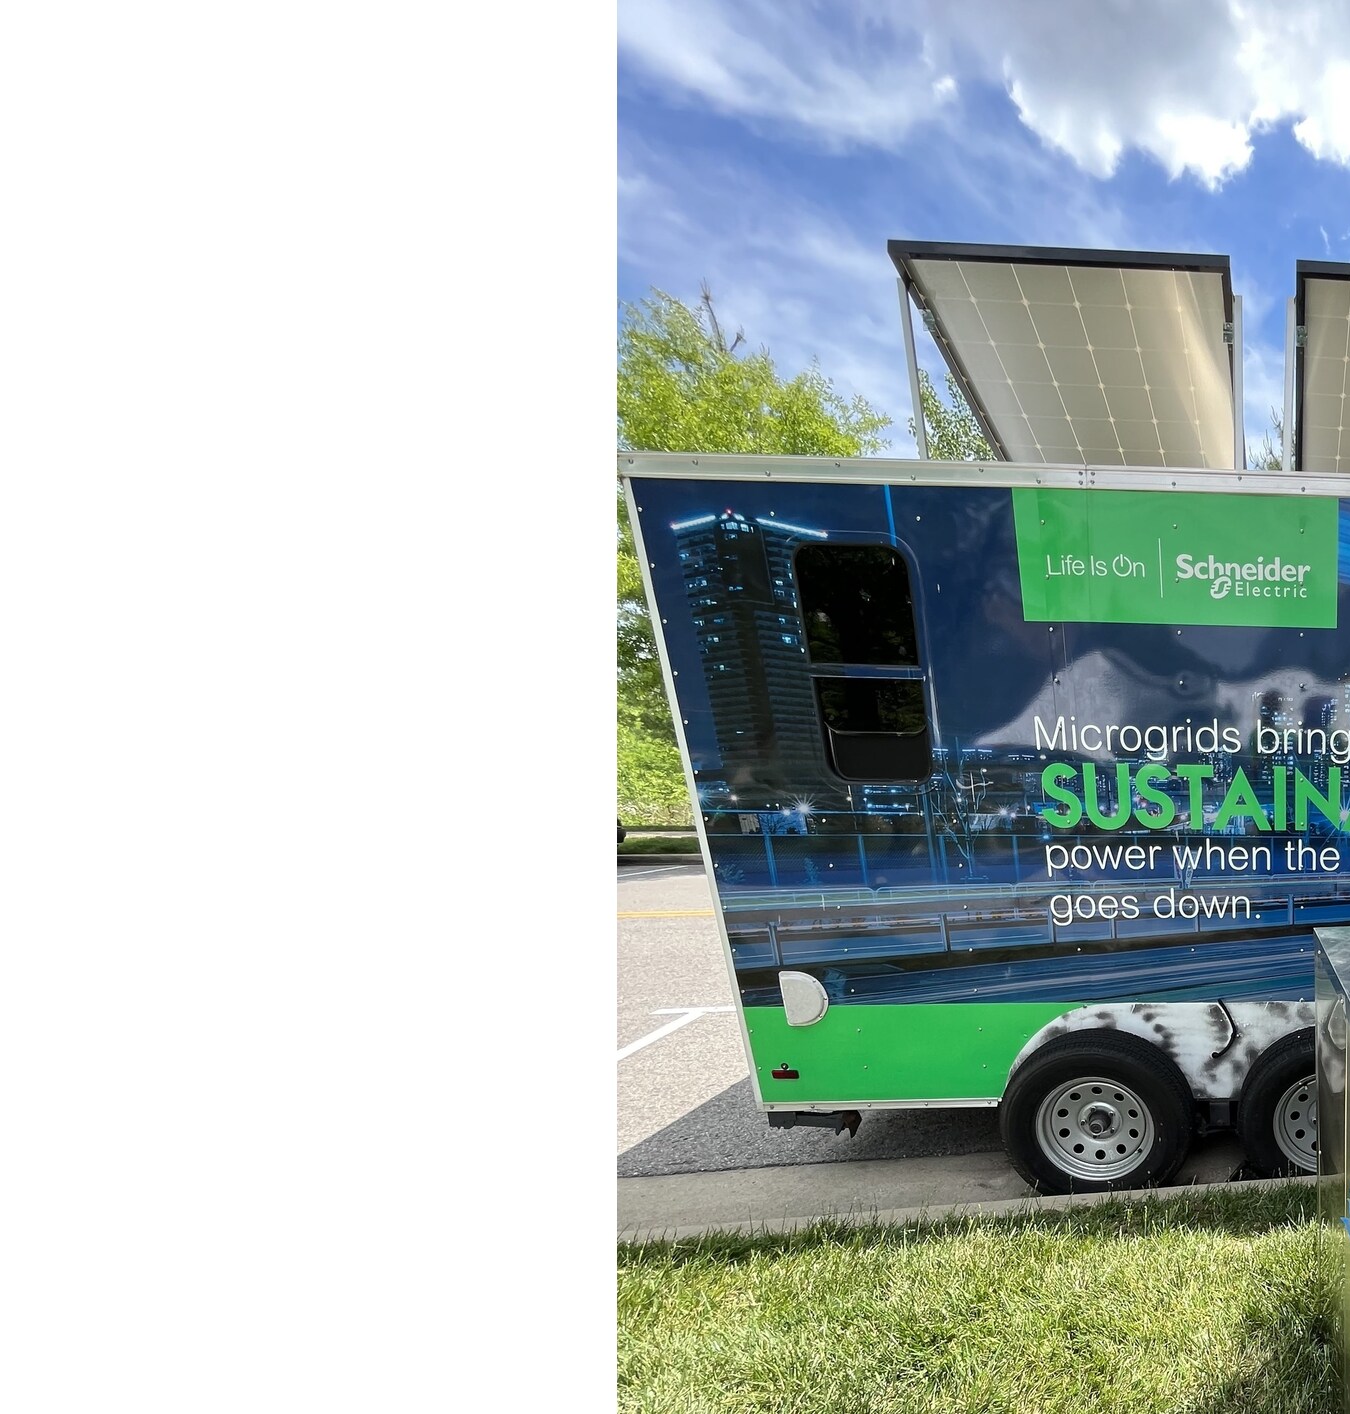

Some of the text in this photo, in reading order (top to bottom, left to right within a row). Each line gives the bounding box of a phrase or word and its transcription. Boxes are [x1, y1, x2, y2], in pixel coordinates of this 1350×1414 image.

[1046, 553, 1146, 578] Life Is On
[1176, 554, 1311, 582] Schneider
[1235, 582, 1308, 598] Electric
[1034, 715, 1242, 758] Microgrids
[1045, 842, 1162, 877] power
[1172, 838, 1272, 871] when
[1284, 838, 1341, 873] the
[1050, 887, 1263, 926] goes down.
